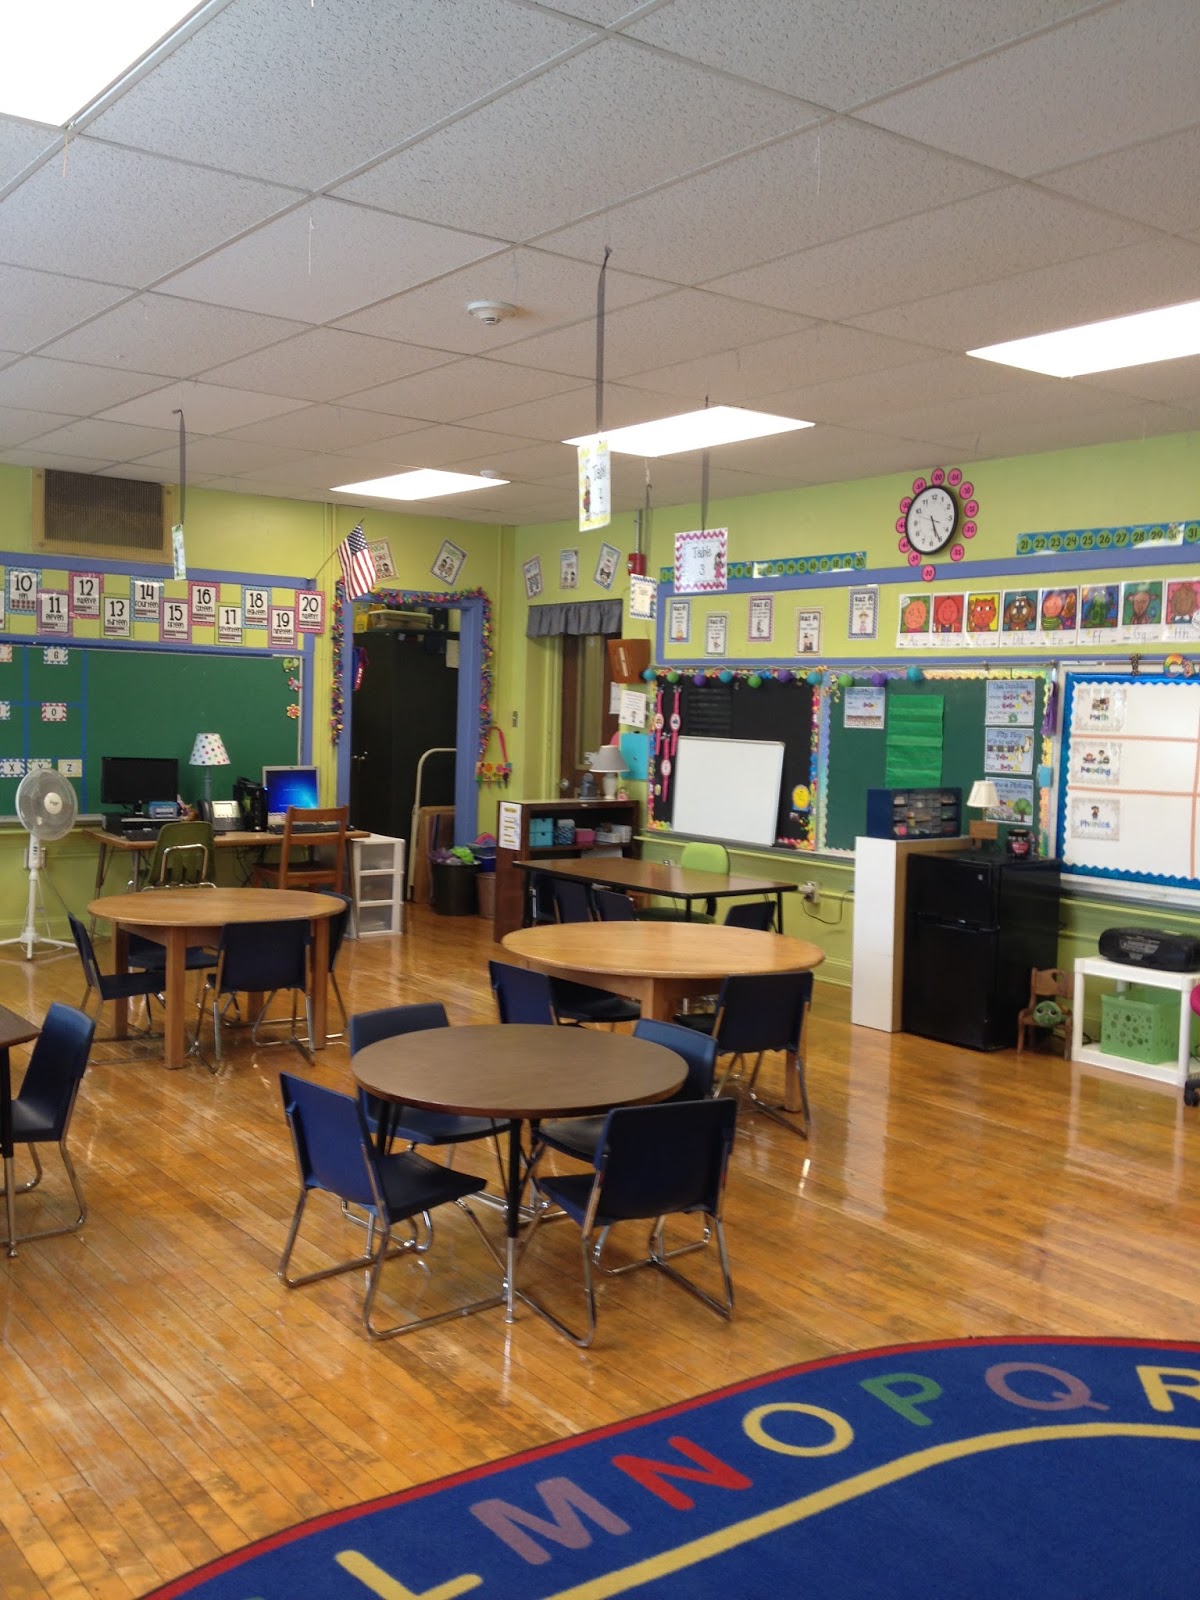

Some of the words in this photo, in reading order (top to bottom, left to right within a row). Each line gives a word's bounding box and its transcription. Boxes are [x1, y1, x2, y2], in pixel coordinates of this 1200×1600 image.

[1021, 539, 1029, 550] 21
[1035, 538, 1046, 548] 22
[1051, 537, 1061, 547] 23
[1066, 536, 1077, 546] 24
[1082, 535, 1093, 545] 25
[1099, 534, 1111, 544] 26
[1116, 533, 1127, 543] 27
[1134, 532, 1145, 542] 28
[1151, 530, 1163, 540] 29
[1188, 527, 1198, 538] 31
[692, 546, 712, 558] Table
[699, 563, 705, 576] 3
[15, 574, 32, 592] 10
[79, 579, 94, 596] 12
[140, 584, 154, 600] 14
[197, 588, 211, 605] 16
[250, 592, 264, 608] 18
[49, 596, 61, 613] 11
[110, 600, 125, 617] 13
[301, 596, 319, 612] 20
[45, 613, 64, 621] eleven
[169, 605, 183, 621] 15
[225, 609, 237, 625] 17
[276, 612, 290, 628] 19
[53, 651, 59, 660] G
[1089, 713, 1109, 721] Math
[9, 763, 15, 772] X
[66, 763, 72, 772] Z
[1080, 765, 1111, 777] Reading
[1080, 819, 1110, 829] Phonics
[335, 1550, 483, 1600] L
[469, 1476, 632, 1565] M
[611, 1435, 753, 1511] N
[742, 1402, 855, 1457] O
[859, 1372, 943, 1426] P
[985, 1361, 1110, 1411] Q
[1136, 1365, 1200, 1412] R
